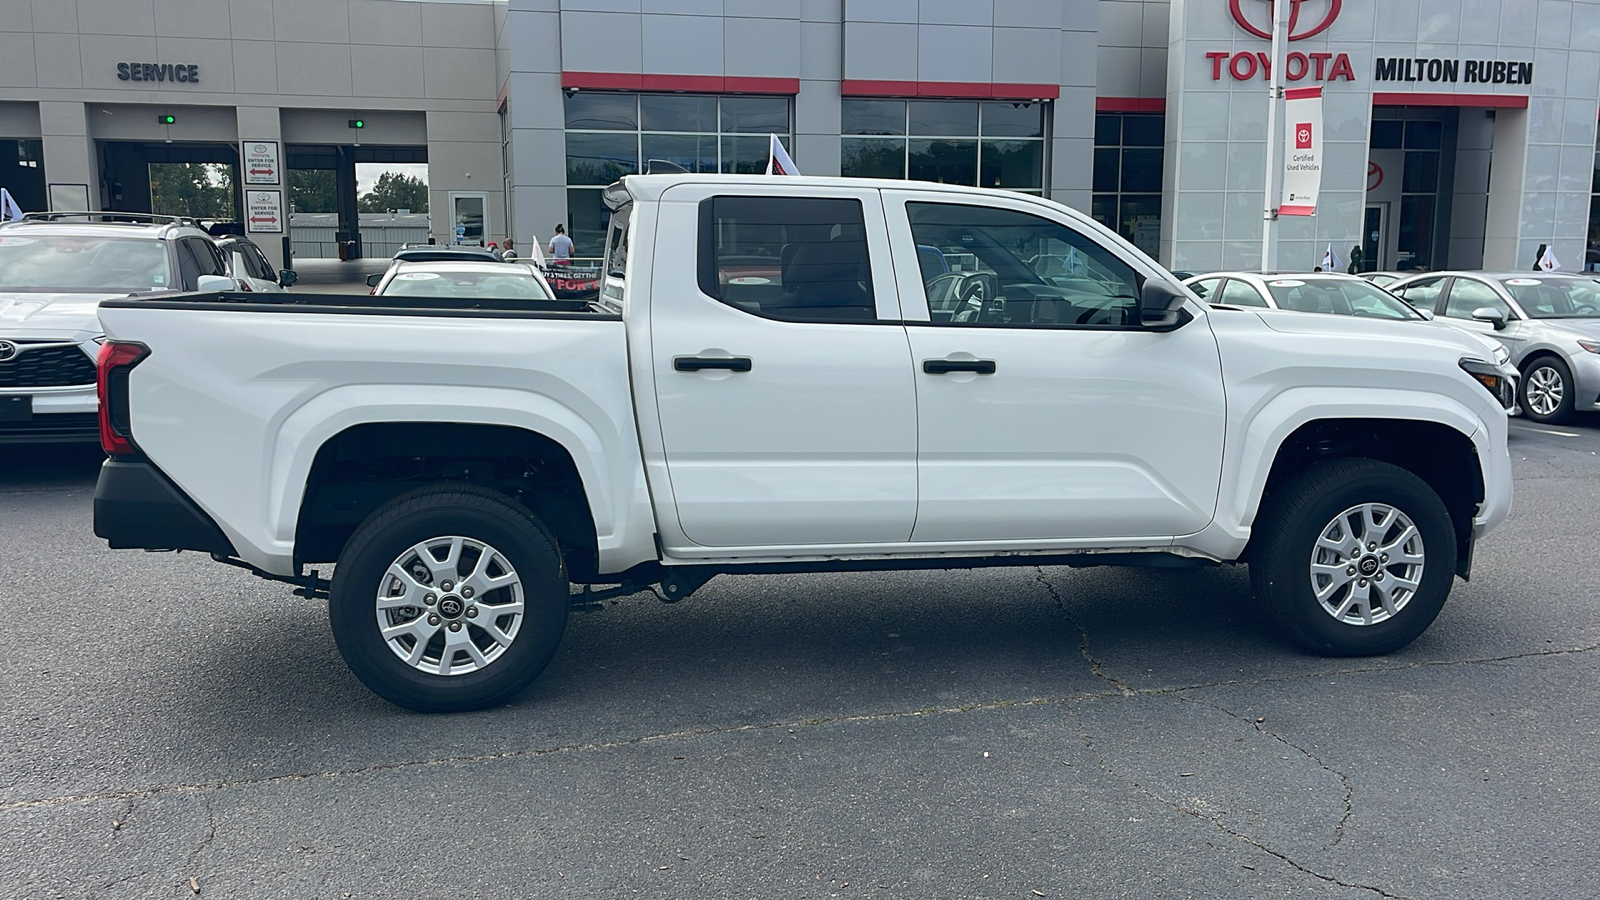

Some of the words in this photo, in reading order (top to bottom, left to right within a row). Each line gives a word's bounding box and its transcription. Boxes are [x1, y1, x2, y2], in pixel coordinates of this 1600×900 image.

[117, 62, 199, 83] SERVICE
[1205, 51, 1356, 81] TOYOTA
[1375, 58, 1459, 83] MILTON
[1464, 60, 1533, 85] RUBEN
[1293, 154, 1315, 162] Certified
[1299, 163, 1320, 171] Vehicles
[557, 279, 587, 290] FOR
